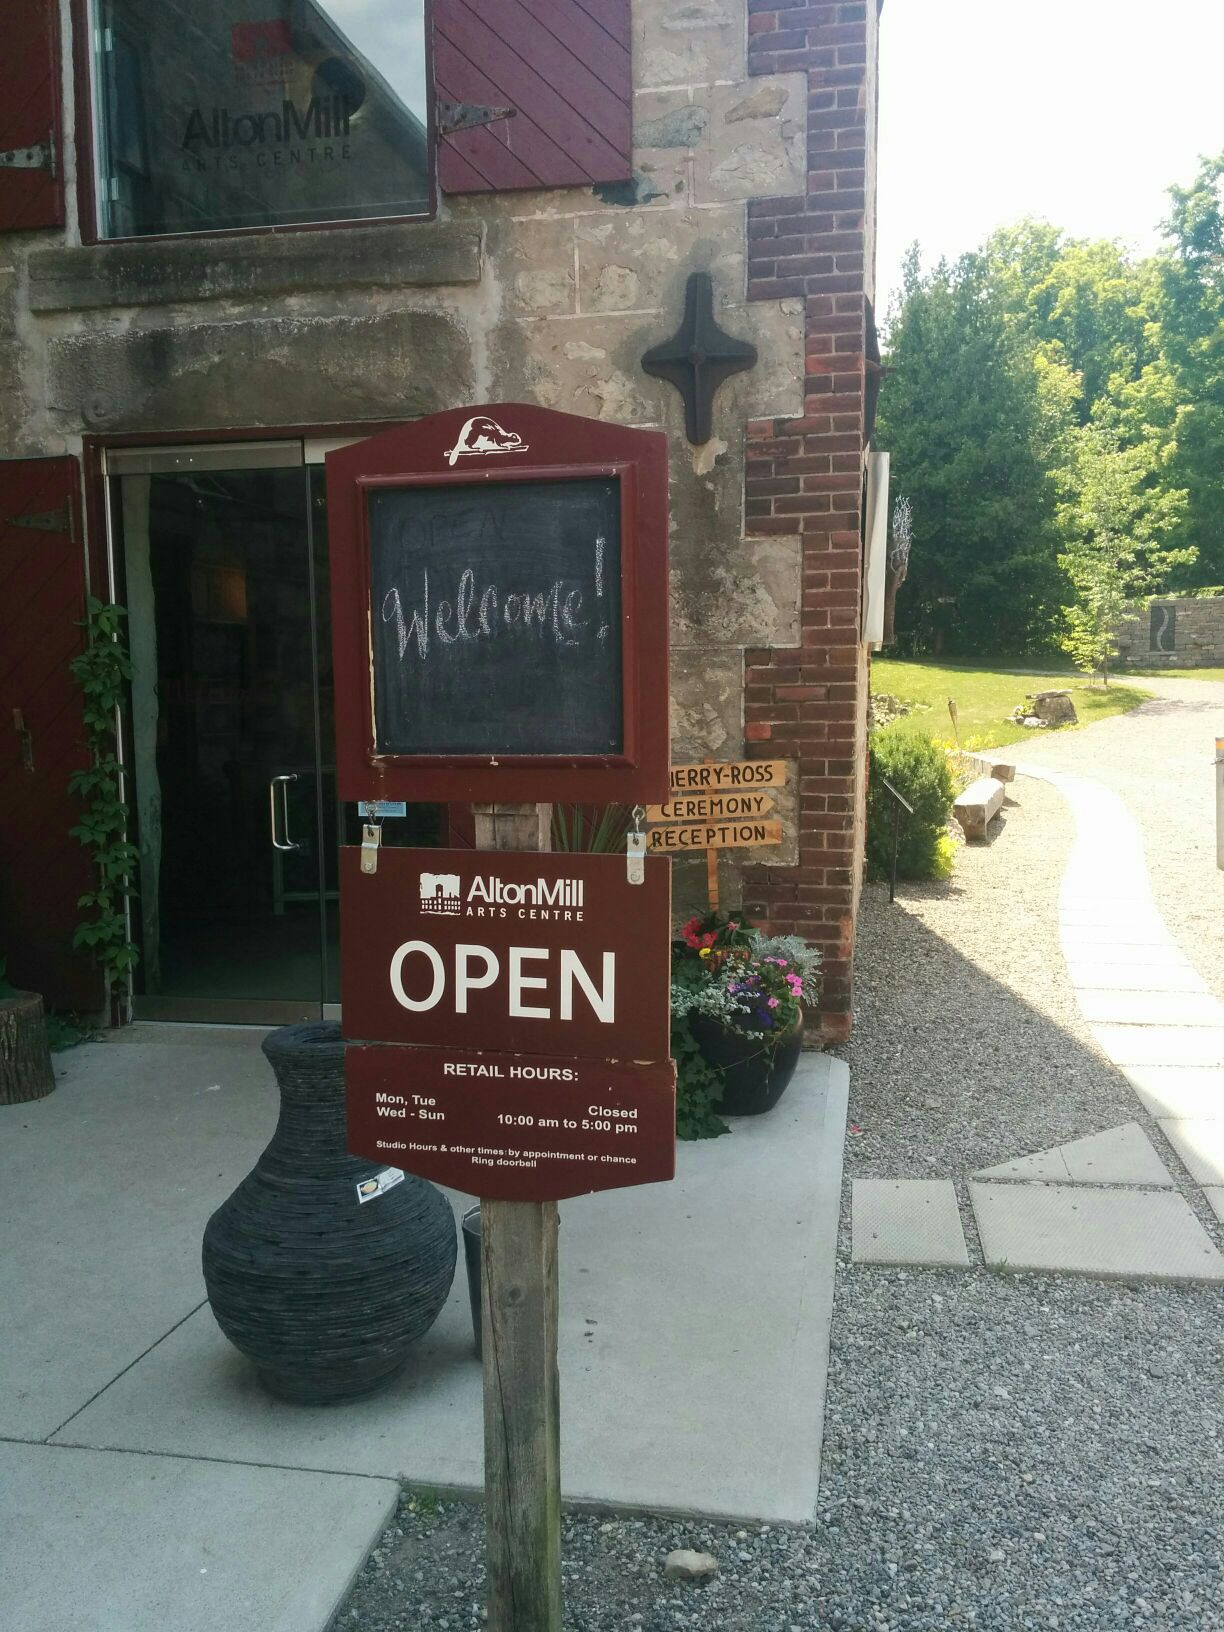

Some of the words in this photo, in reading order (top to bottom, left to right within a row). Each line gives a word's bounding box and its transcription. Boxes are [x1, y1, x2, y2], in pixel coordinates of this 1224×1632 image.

[182, 95, 351, 149] AltonMill
[181, 155, 239, 172] ARTS
[256, 144, 352, 167] CENTRE
[671, 764, 773, 788] ERRY-ROSS
[660, 796, 764, 817] CEREMONY
[651, 825, 766, 848] RECEPTION
[466, 875, 584, 907] AltonMill
[466, 906, 507, 918] ARTS
[518, 908, 584, 922] CENTRE
[389, 940, 616, 1024] OPEN
[443, 1063, 505, 1078] RETAIL
[509, 1066, 579, 1081] HOURS:
[375, 1092, 408, 1106] Mon,
[411, 1094, 436, 1106] Tue
[376, 1106, 406, 1118] Wed
[418, 1109, 445, 1120] Sun
[588, 1105, 638, 1119] Closed
[497, 1113, 534, 1126] 10:00
[538, 1118, 559, 1128] am
[563, 1118, 577, 1129] to
[581, 1119, 611, 1131] 5:00
[615, 1122, 638, 1134] pm
[376, 1140, 407, 1150] Studio
[409, 1142, 438, 1151] Hours
[440, 1144, 448, 1152] &
[450, 1145, 475, 1154] other
[508, 1148, 520, 1157] by
[523, 1149, 585, 1160] appointment
[600, 1155, 637, 1164] chance
[471, 1156, 494, 1166] Ring
[496, 1158, 537, 1168] doorbell
